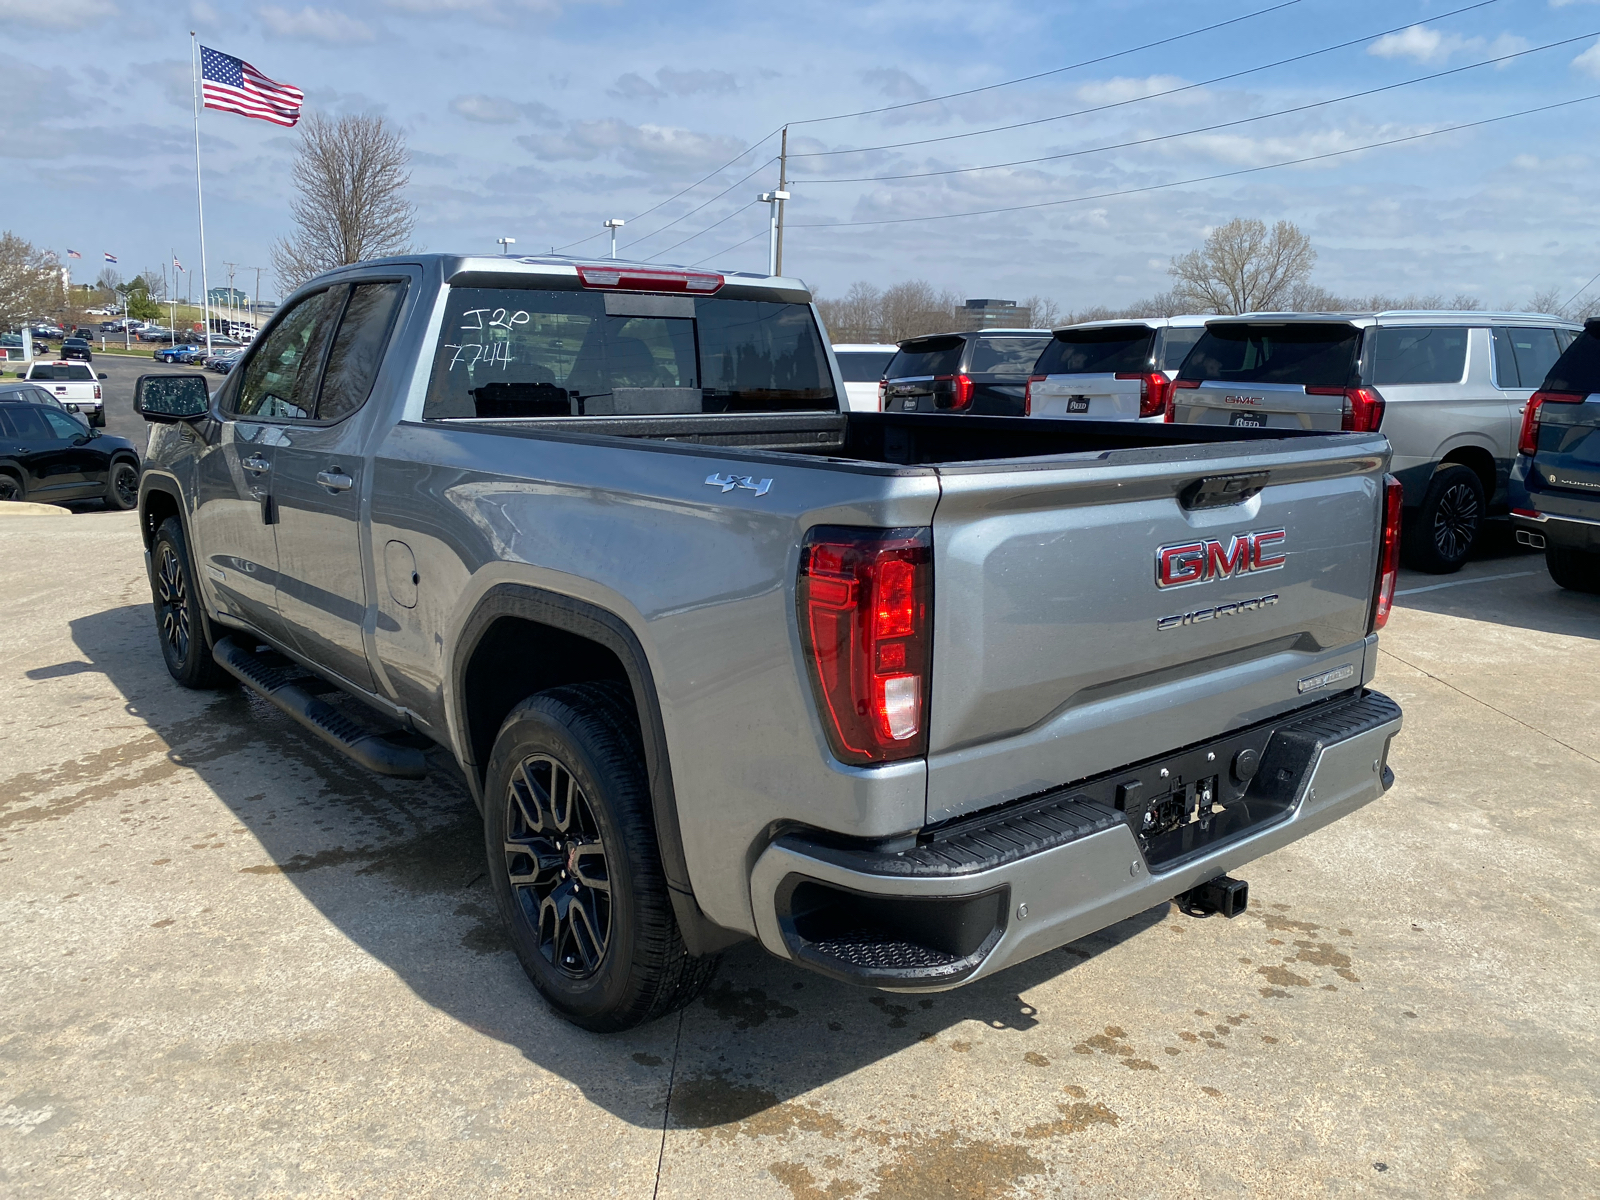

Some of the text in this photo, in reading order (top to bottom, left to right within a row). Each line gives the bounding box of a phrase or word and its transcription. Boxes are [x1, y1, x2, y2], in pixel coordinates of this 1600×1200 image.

[444, 341, 512, 371] 7744
[1225, 396, 1265, 405] GMC
[1155, 527, 1286, 591] GMC
[1157, 593, 1279, 631] SIERRA
